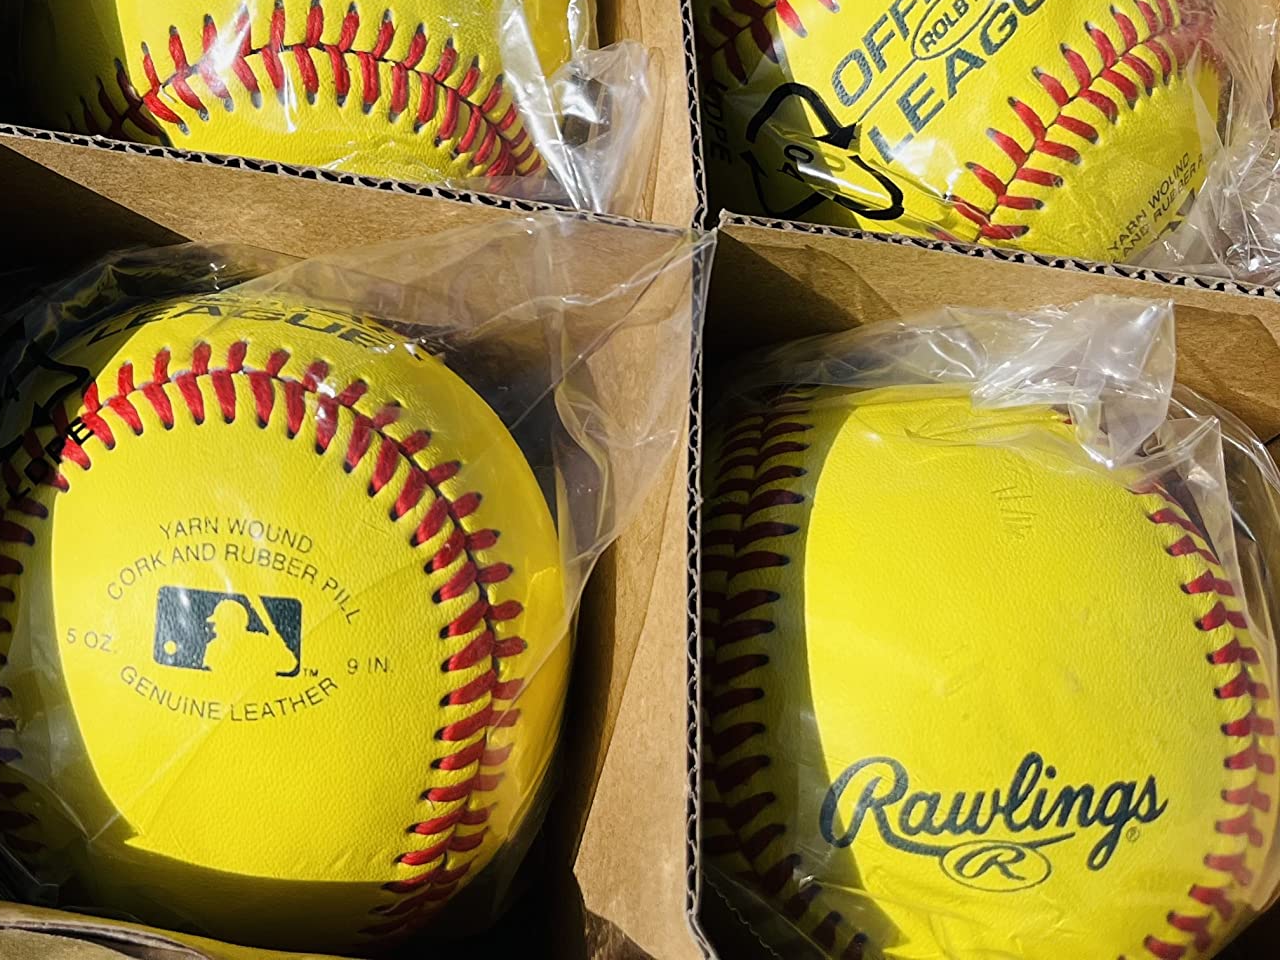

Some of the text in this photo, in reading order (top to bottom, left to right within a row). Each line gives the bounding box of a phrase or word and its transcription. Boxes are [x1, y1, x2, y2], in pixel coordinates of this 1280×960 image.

[1107, 209, 1147, 251] YARN
[159, 517, 314, 554] YARN WOUND
[107, 542, 362, 624] CORK AND RUBBER PILL
[65, 627, 77, 644] 5
[347, 657, 359, 675] 9
[120, 665, 339, 722] GENUINE LEATHER
[819, 751, 1169, 871] Rawlings
